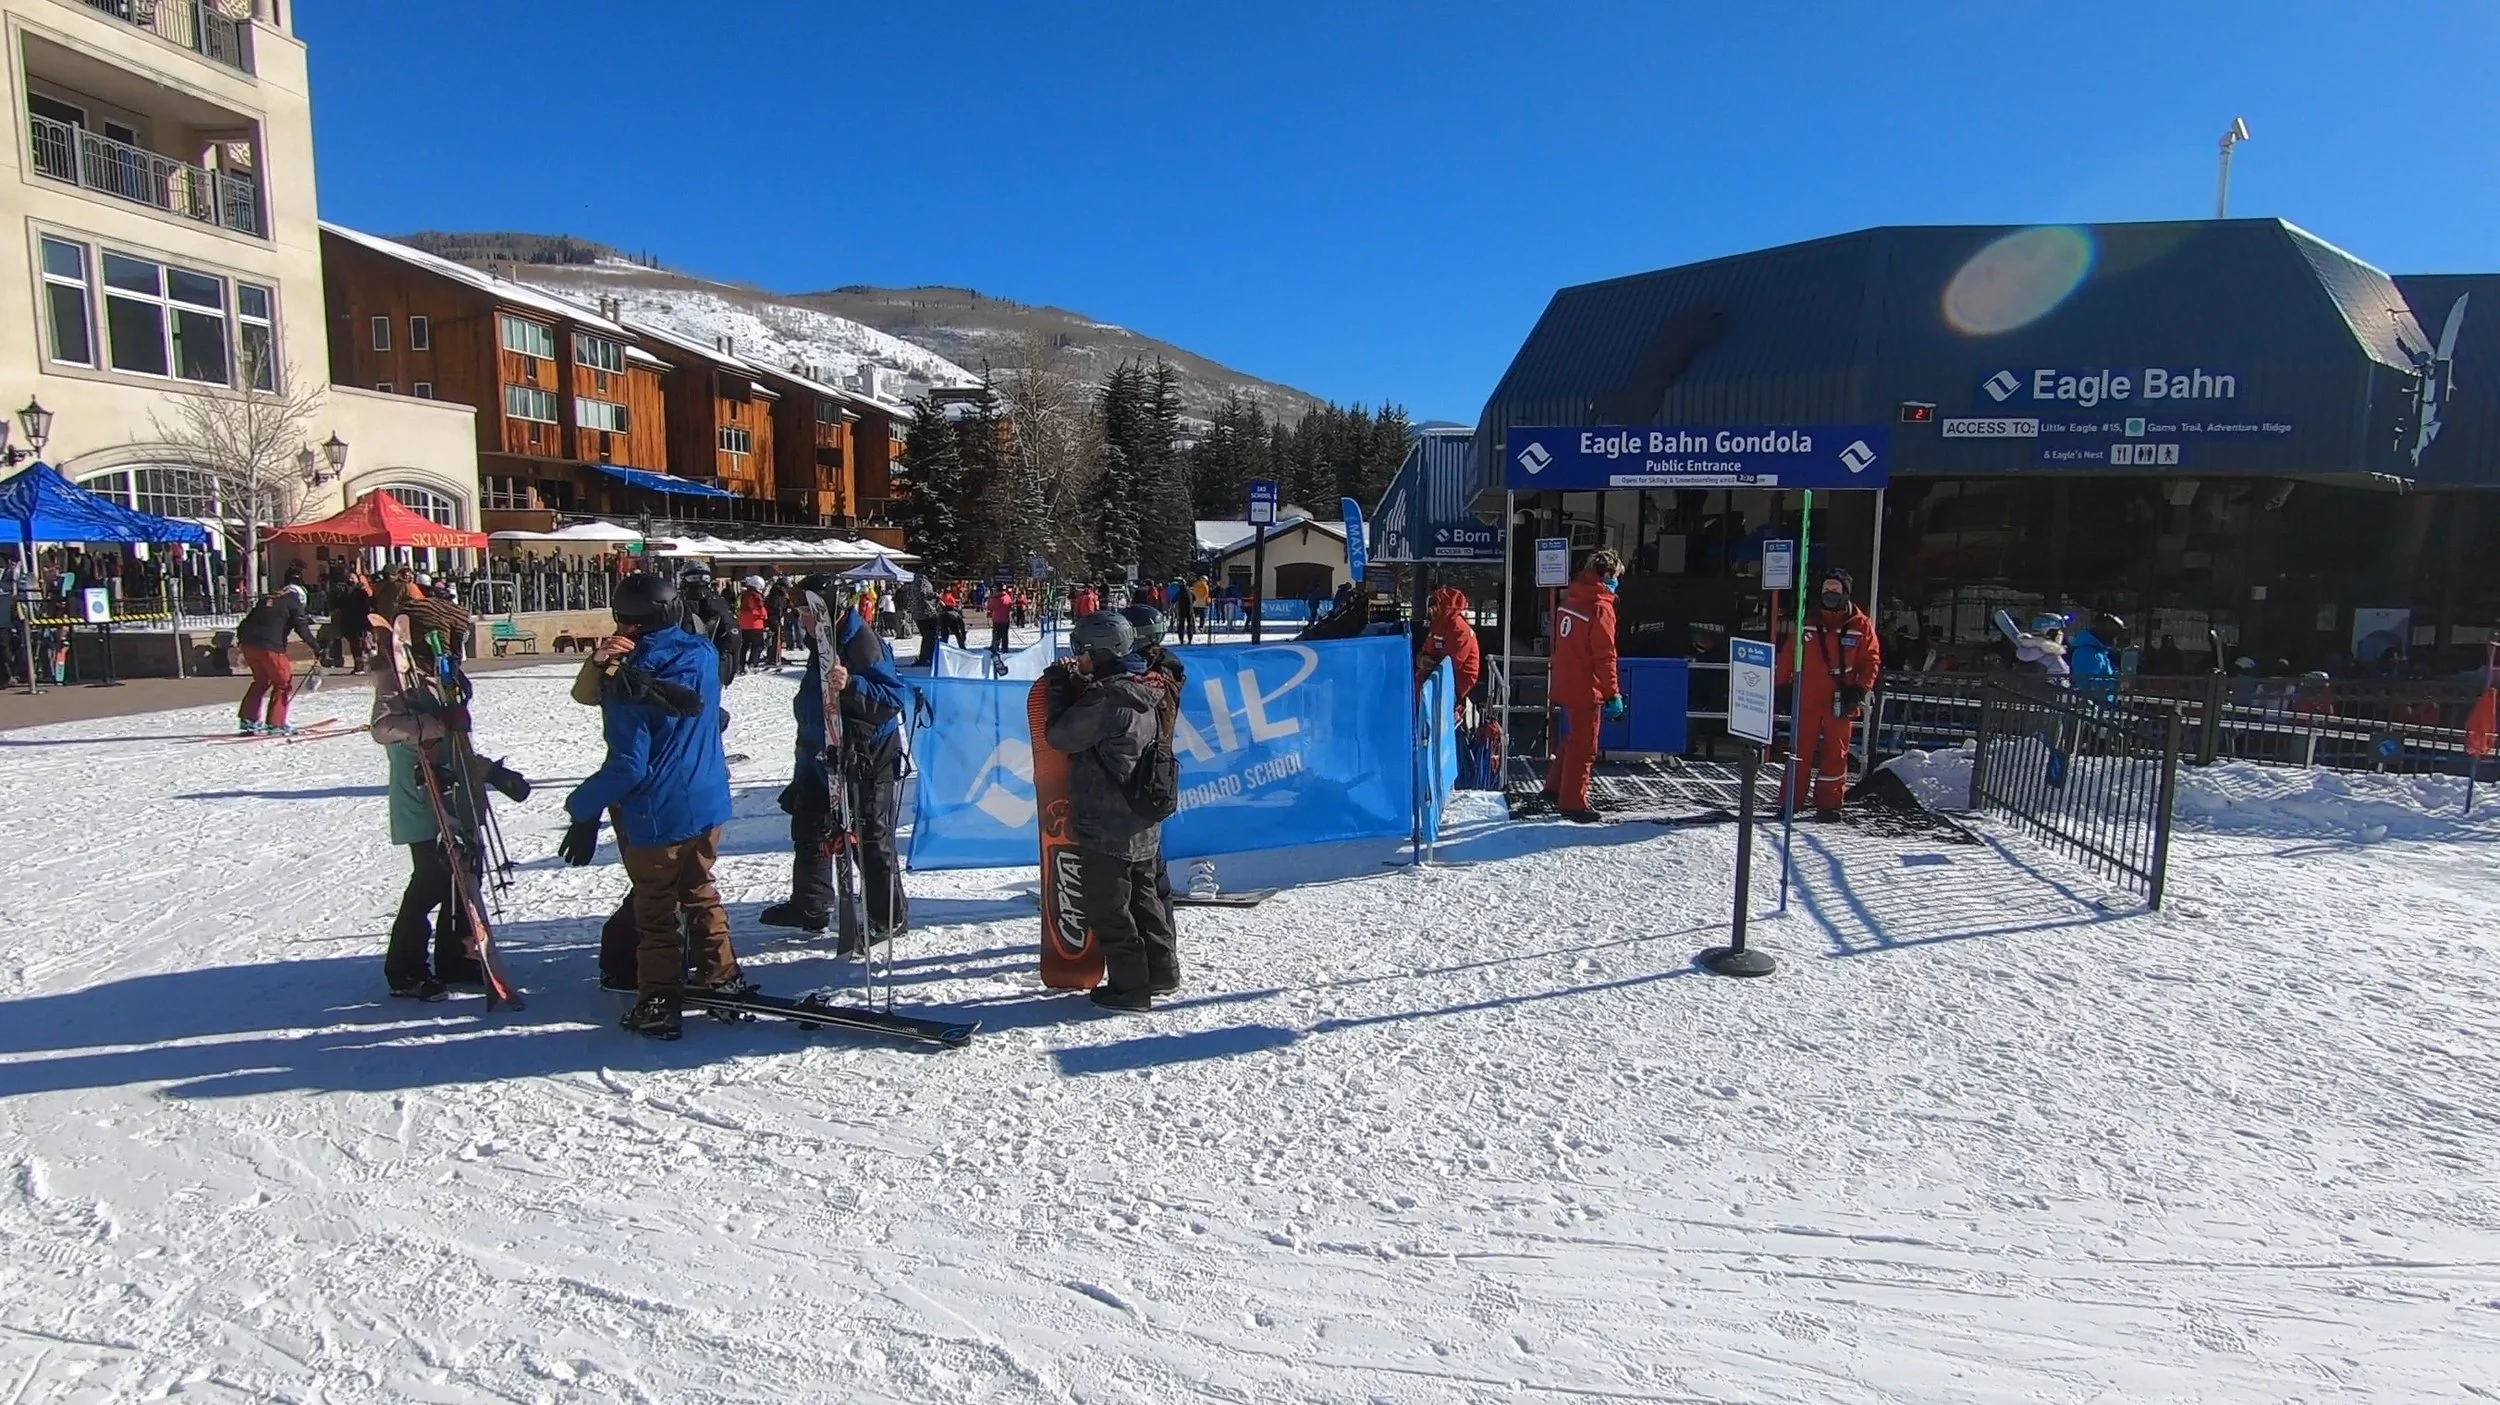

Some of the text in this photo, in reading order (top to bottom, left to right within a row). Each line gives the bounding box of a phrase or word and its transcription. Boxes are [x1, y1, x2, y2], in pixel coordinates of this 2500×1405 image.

[2033, 368, 2236, 407] Eagle Bahn
[1946, 422, 2007, 434] ACCESS
[2012, 422, 2035, 434] TO:
[2041, 423, 2066, 432] Little
[2069, 423, 2098, 434] Eagle
[2147, 423, 2177, 432] Game
[2207, 422, 2258, 432] Adventure
[2262, 422, 2292, 434] Ridge
[1580, 430, 1812, 459] Eagle Bahn Gondola
[2052, 450, 2082, 461] Eagle's
[2084, 451, 2104, 459] Nest
[1646, 459, 1742, 472] Public Entrance
[289, 532, 364, 545] SKI VALET
[411, 532, 470, 547] SKI VALET
[1389, 533, 1397, 546] 8
[1453, 529, 1490, 542] Born
[1350, 524, 1363, 568] MAX 6
[1269, 602, 1292, 612] VAIL
[1172, 667, 1300, 763] AIL
